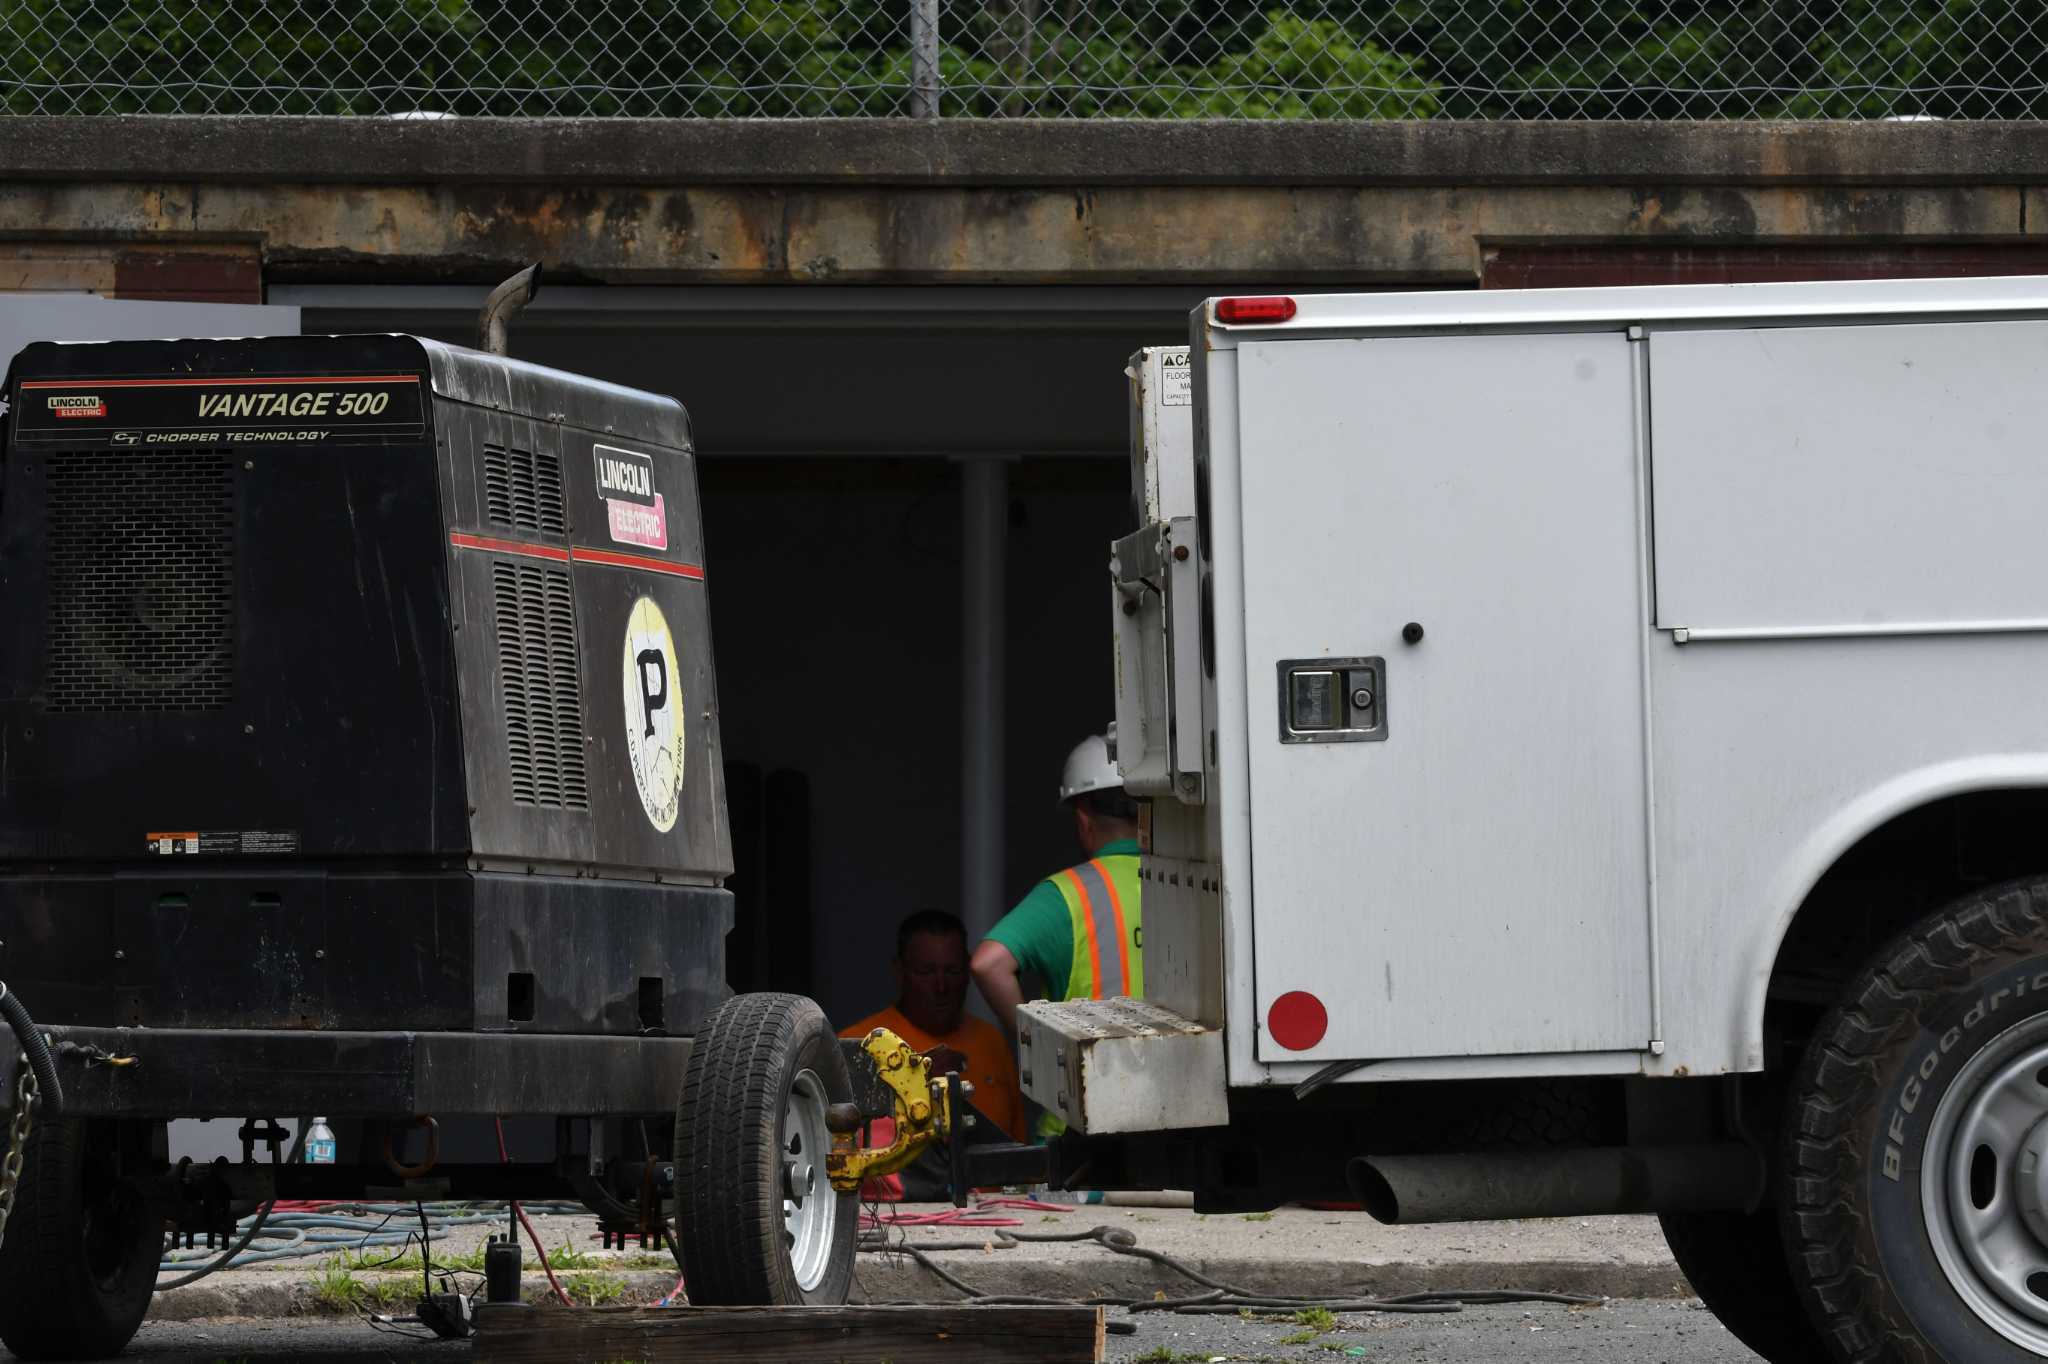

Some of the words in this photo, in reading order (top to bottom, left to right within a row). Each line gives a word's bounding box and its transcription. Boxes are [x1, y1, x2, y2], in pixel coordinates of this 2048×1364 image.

[50, 398, 97, 408] LINCOLN
[61, 408, 102, 416] ELECTRIC
[198, 393, 334, 417] VANTAGE
[336, 392, 389, 416] 500
[146, 433, 220, 443] CHOPPER
[226, 431, 330, 442] TECHNOLOGY
[599, 457, 651, 497] LINCOLN
[615, 507, 661, 539] ELECTRIC
[637, 648, 668, 740] P
